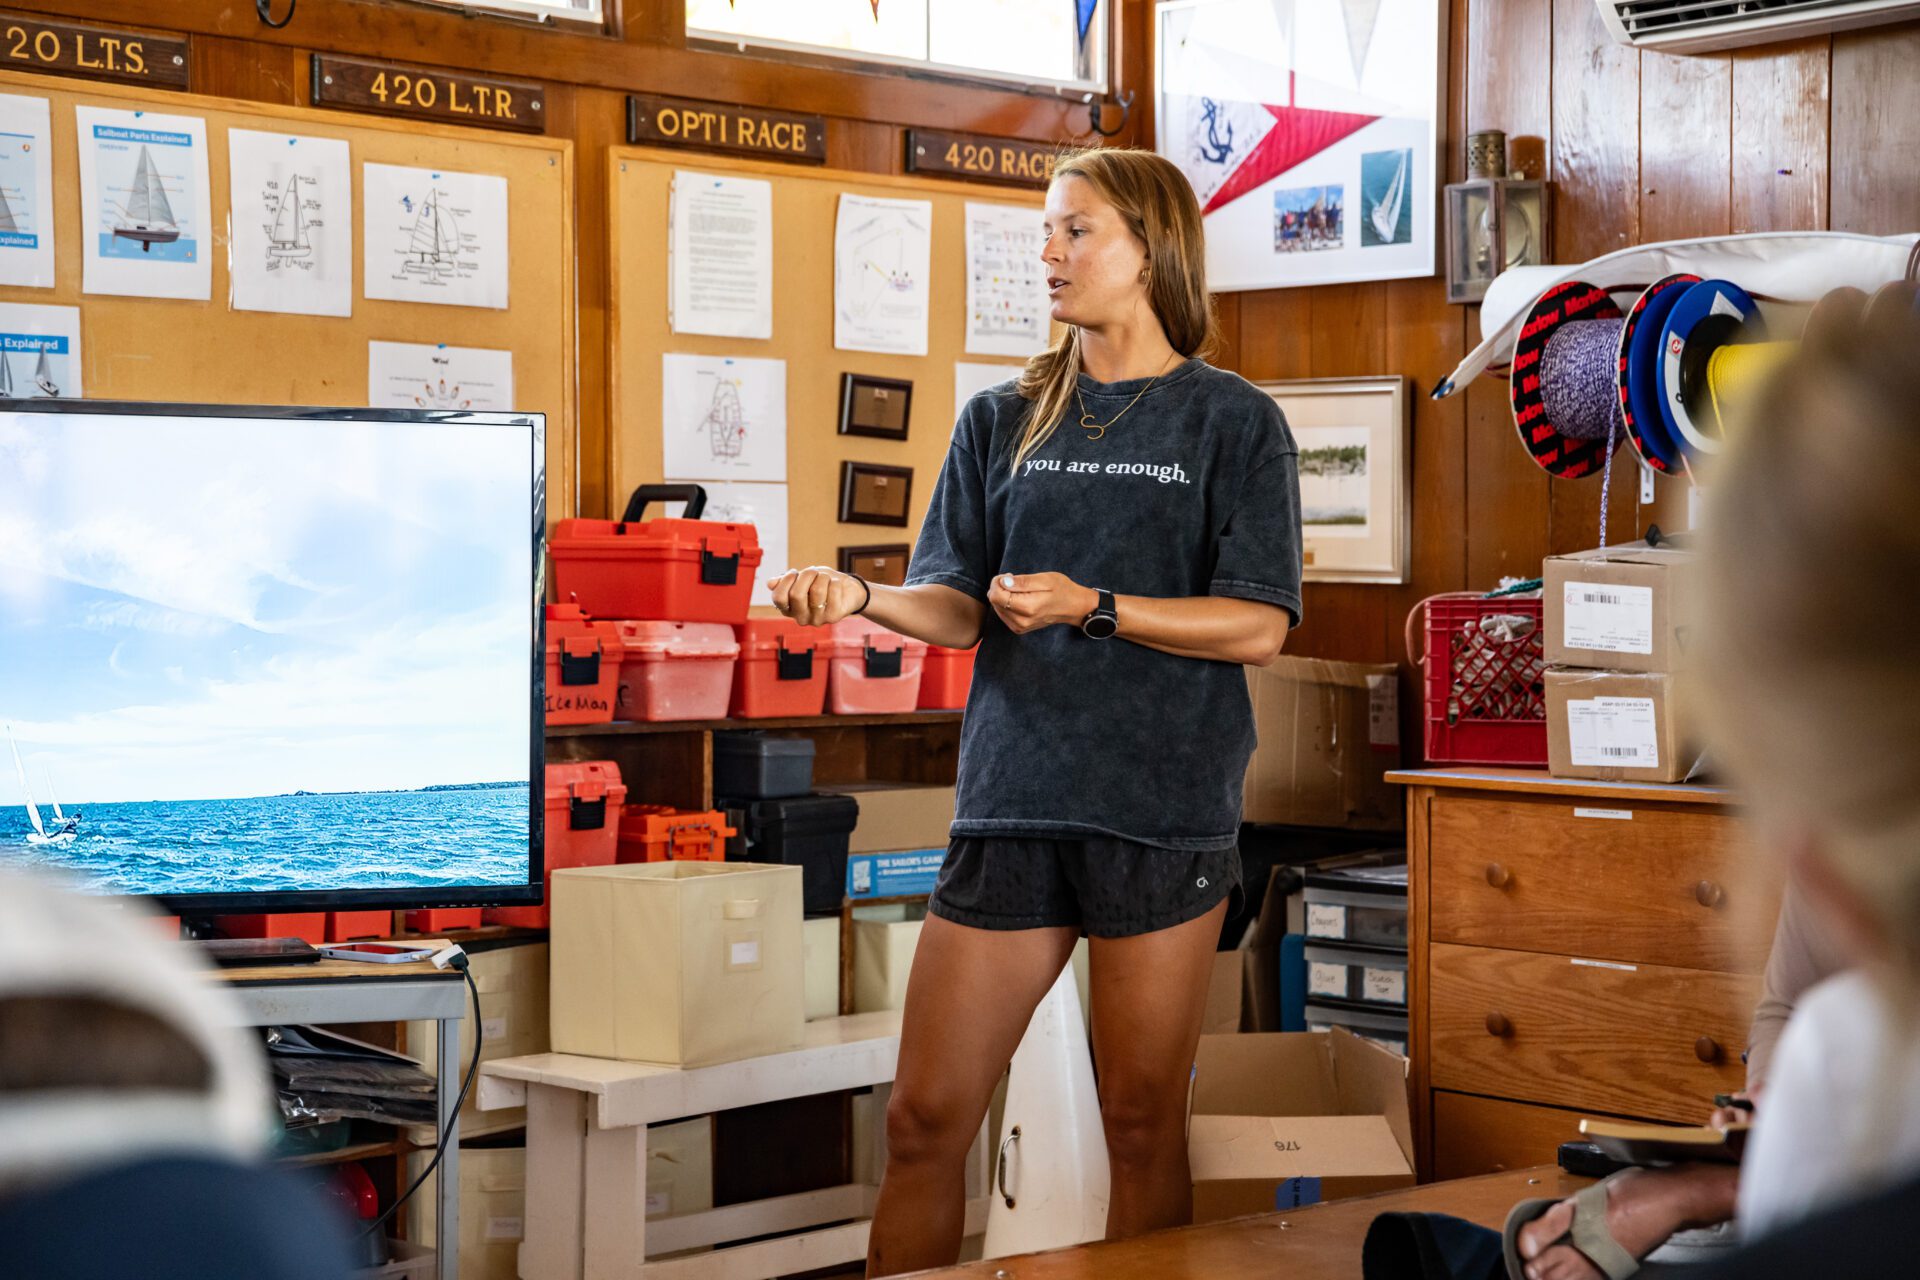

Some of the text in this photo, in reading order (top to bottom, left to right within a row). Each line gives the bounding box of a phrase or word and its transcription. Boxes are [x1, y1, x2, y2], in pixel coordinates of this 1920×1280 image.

[370, 72, 517, 119] 420 L.T.R.
[151, 133, 189, 145] Explained
[657, 108, 807, 152] OPTI RACE
[945, 142, 995, 172] 420
[1024, 459, 1191, 484] you are enough.
[1274, 1141, 1301, 1152] 176
